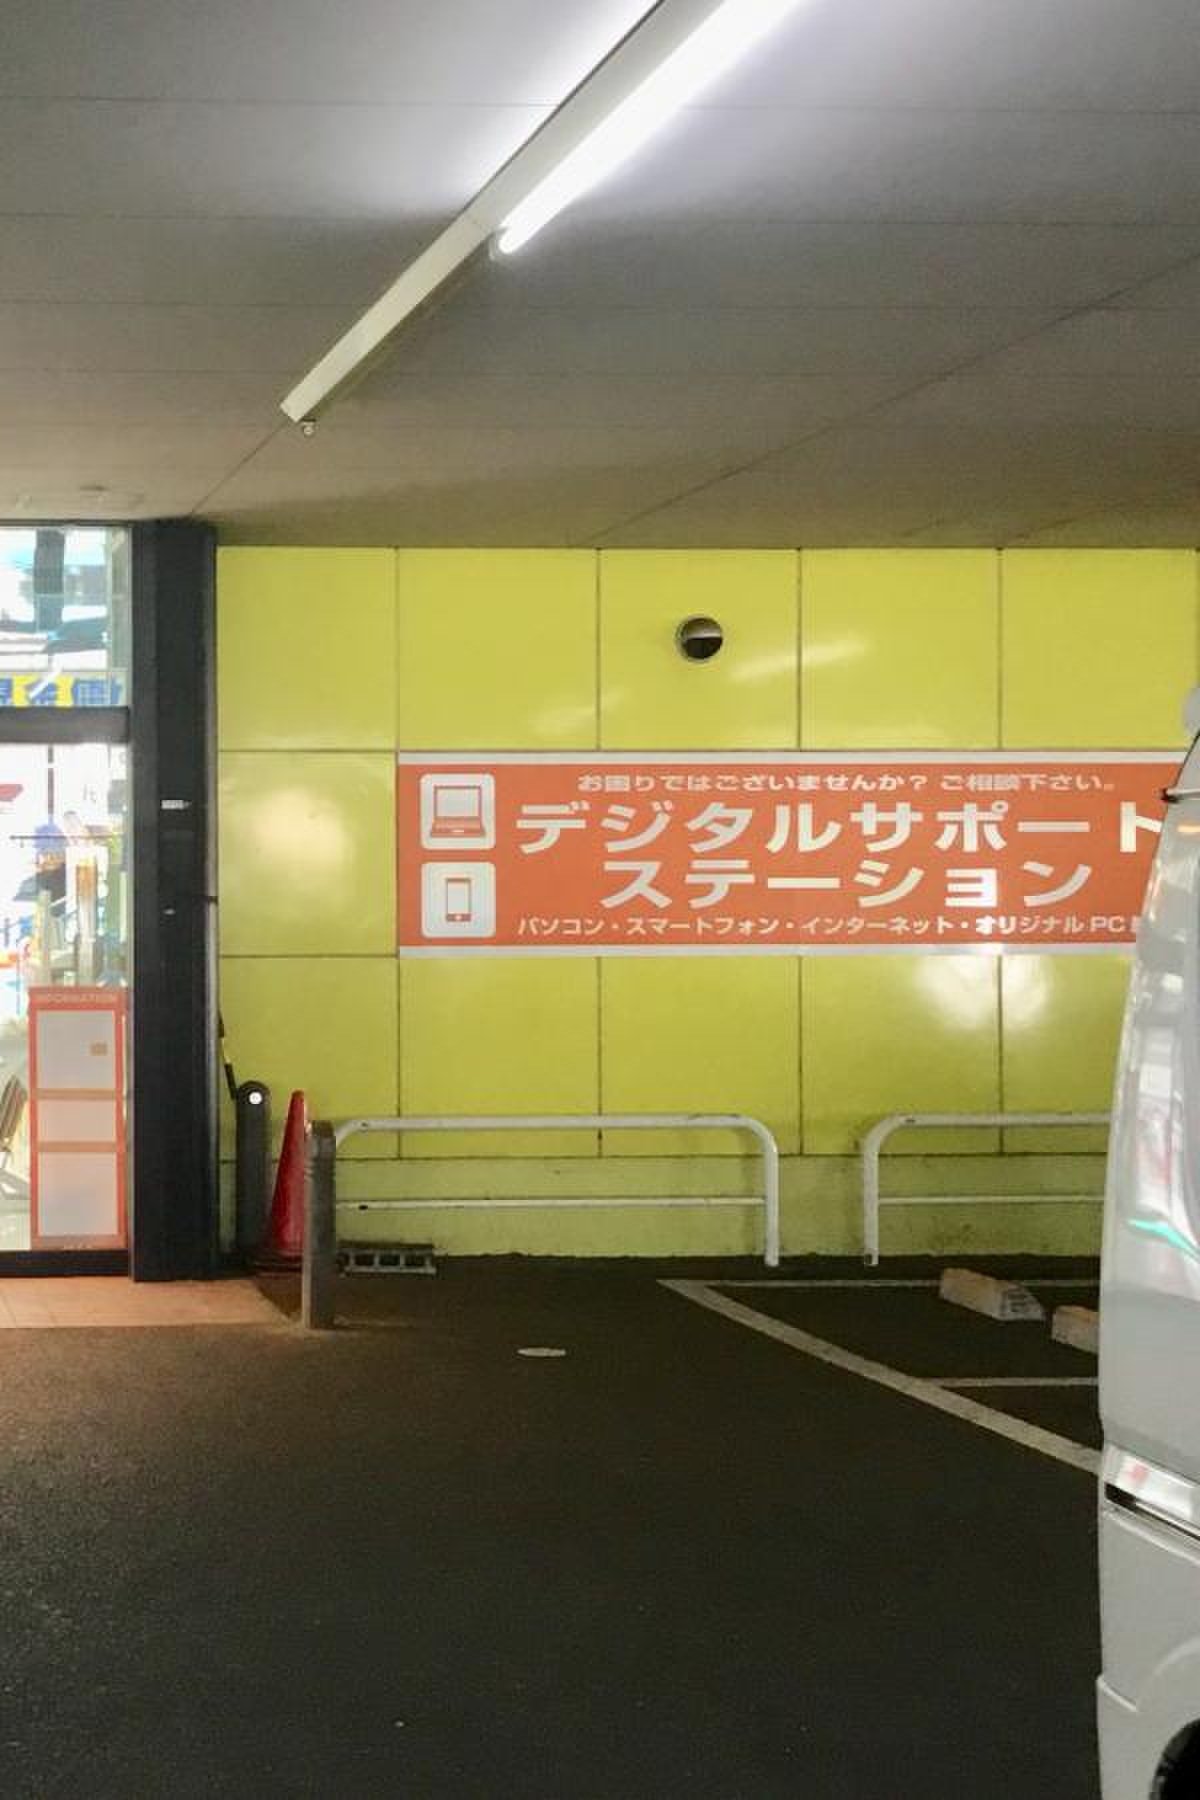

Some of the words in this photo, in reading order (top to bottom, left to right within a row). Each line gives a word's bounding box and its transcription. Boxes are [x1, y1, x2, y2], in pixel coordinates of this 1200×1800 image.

[516, 799, 1162, 855] デジタルサポート
[600, 859, 1092, 909] ステーション
